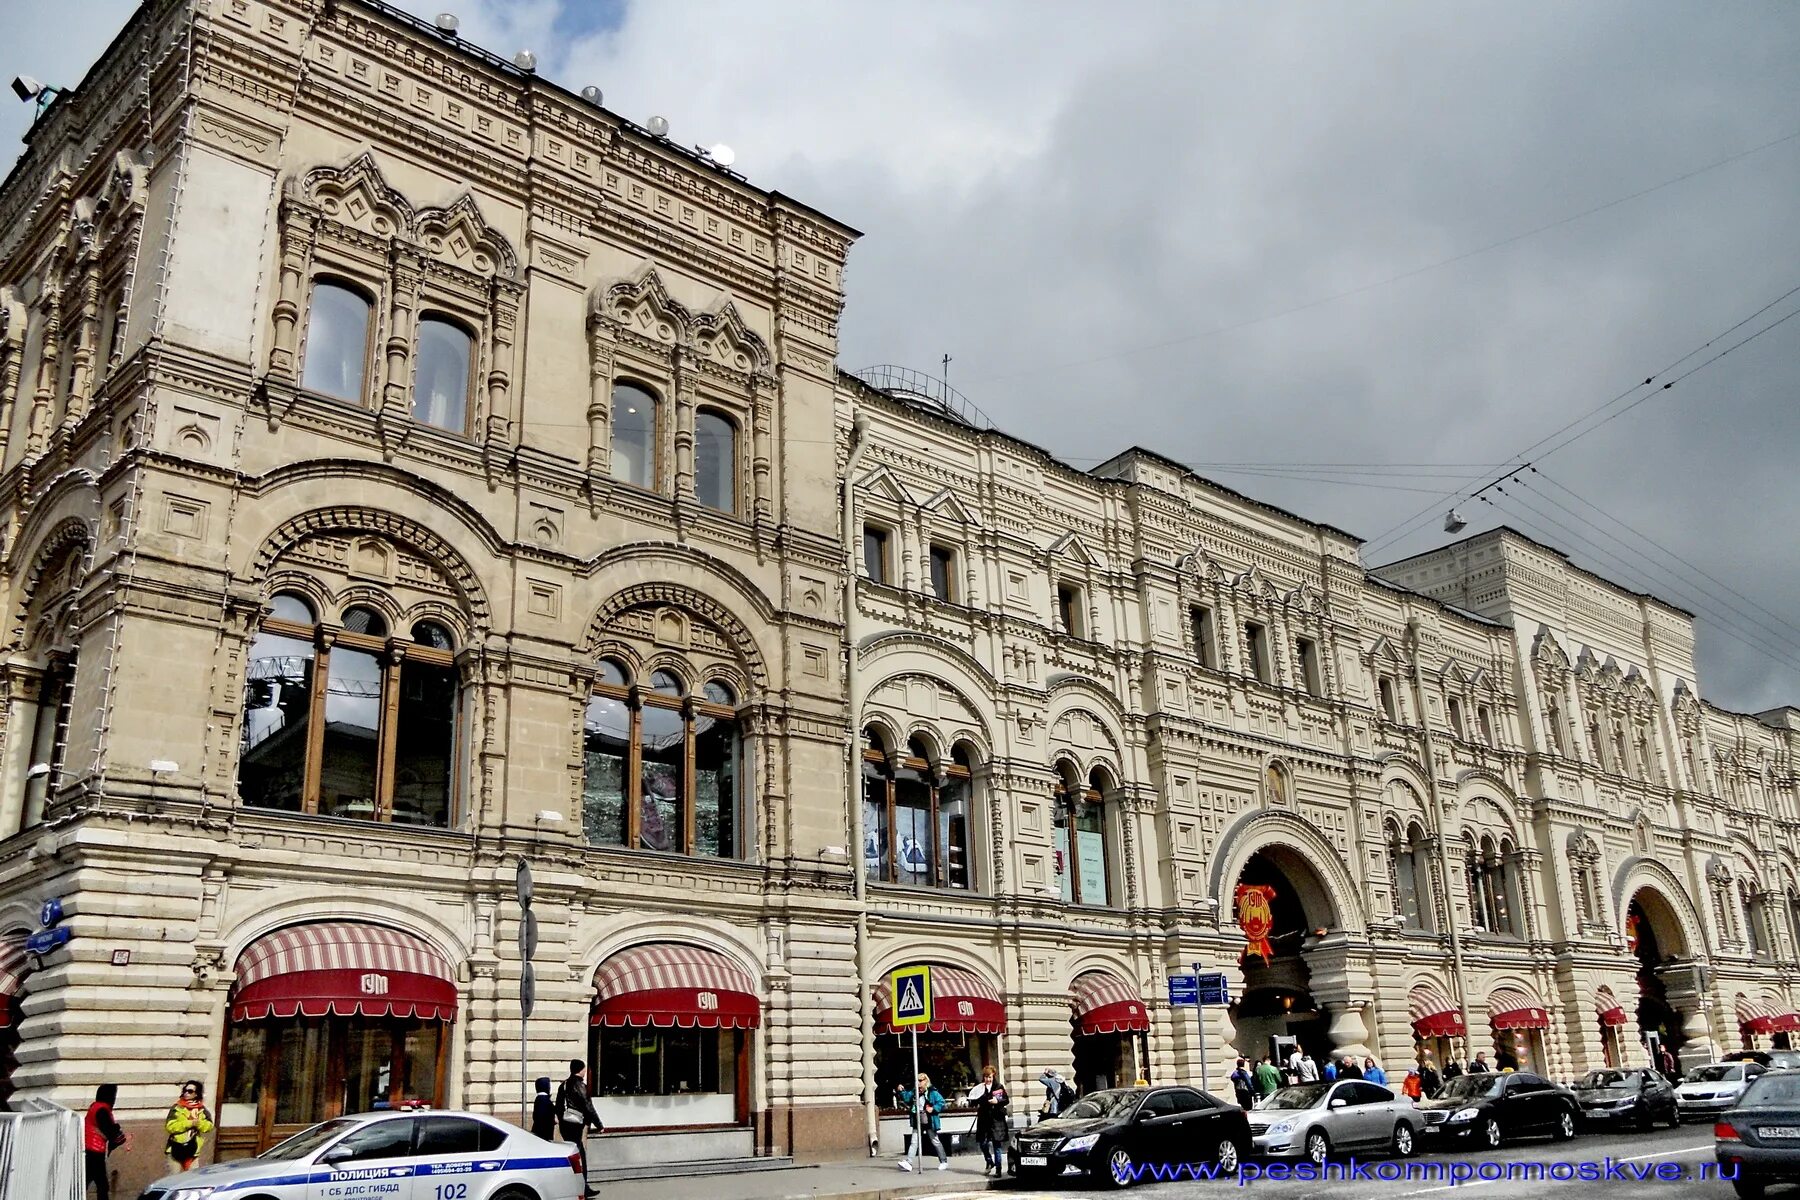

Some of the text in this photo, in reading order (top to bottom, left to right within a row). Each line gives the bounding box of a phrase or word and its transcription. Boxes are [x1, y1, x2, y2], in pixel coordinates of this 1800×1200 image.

[44, 903, 53, 922] 3
[361, 973, 389, 995] ГУМ
[697, 991, 719, 1010] ГУМ
[330, 1168, 390, 1181] ПОЛИЦИЯ
[328, 1187, 342, 1196] СБ
[345, 1185, 366, 1195] ДПС
[369, 1183, 400, 1194] ГИБДД
[434, 1183, 467, 1200] 102
